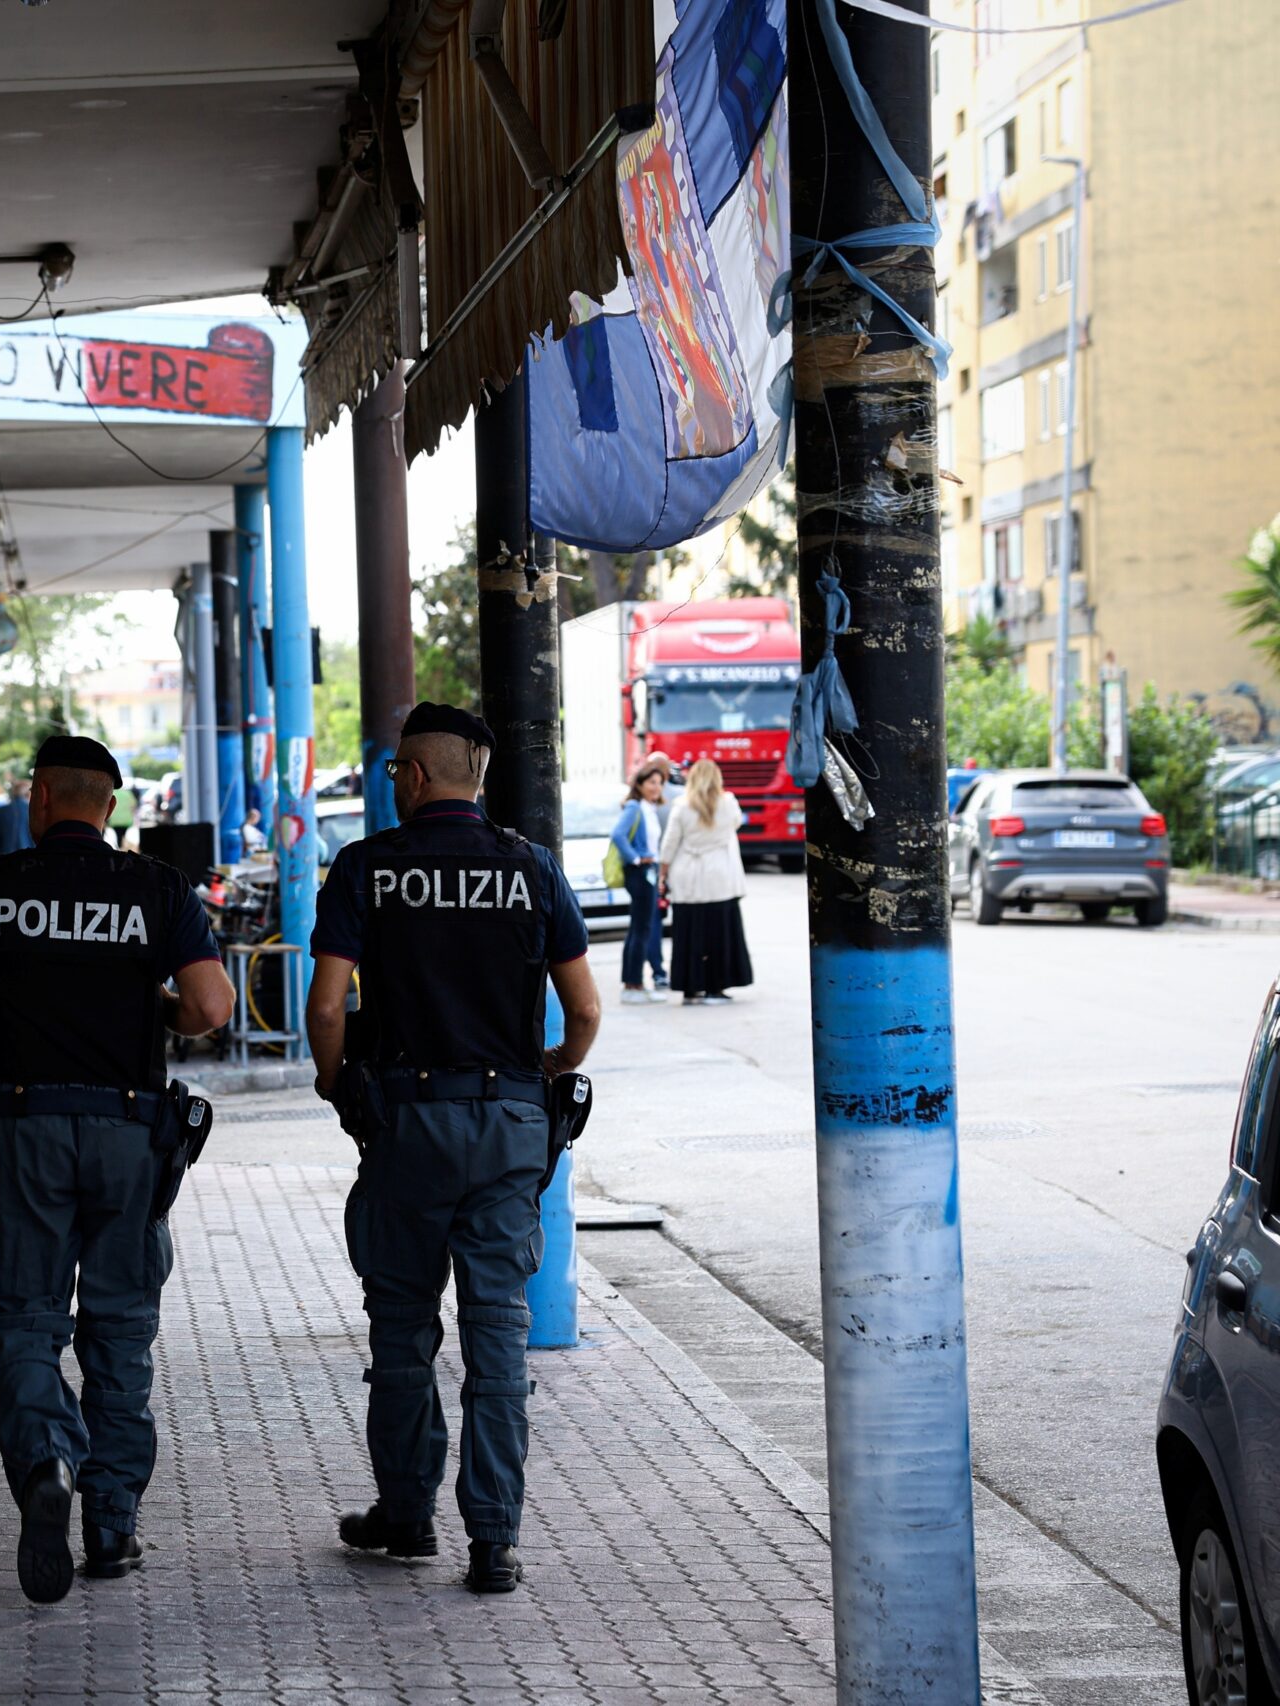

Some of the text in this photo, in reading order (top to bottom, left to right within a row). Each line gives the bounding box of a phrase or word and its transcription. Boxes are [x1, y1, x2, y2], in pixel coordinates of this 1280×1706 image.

[46, 345, 209, 409] VIVERE
[701, 666, 781, 682] ARCANGELO
[373, 868, 533, 911] POLIZIA
